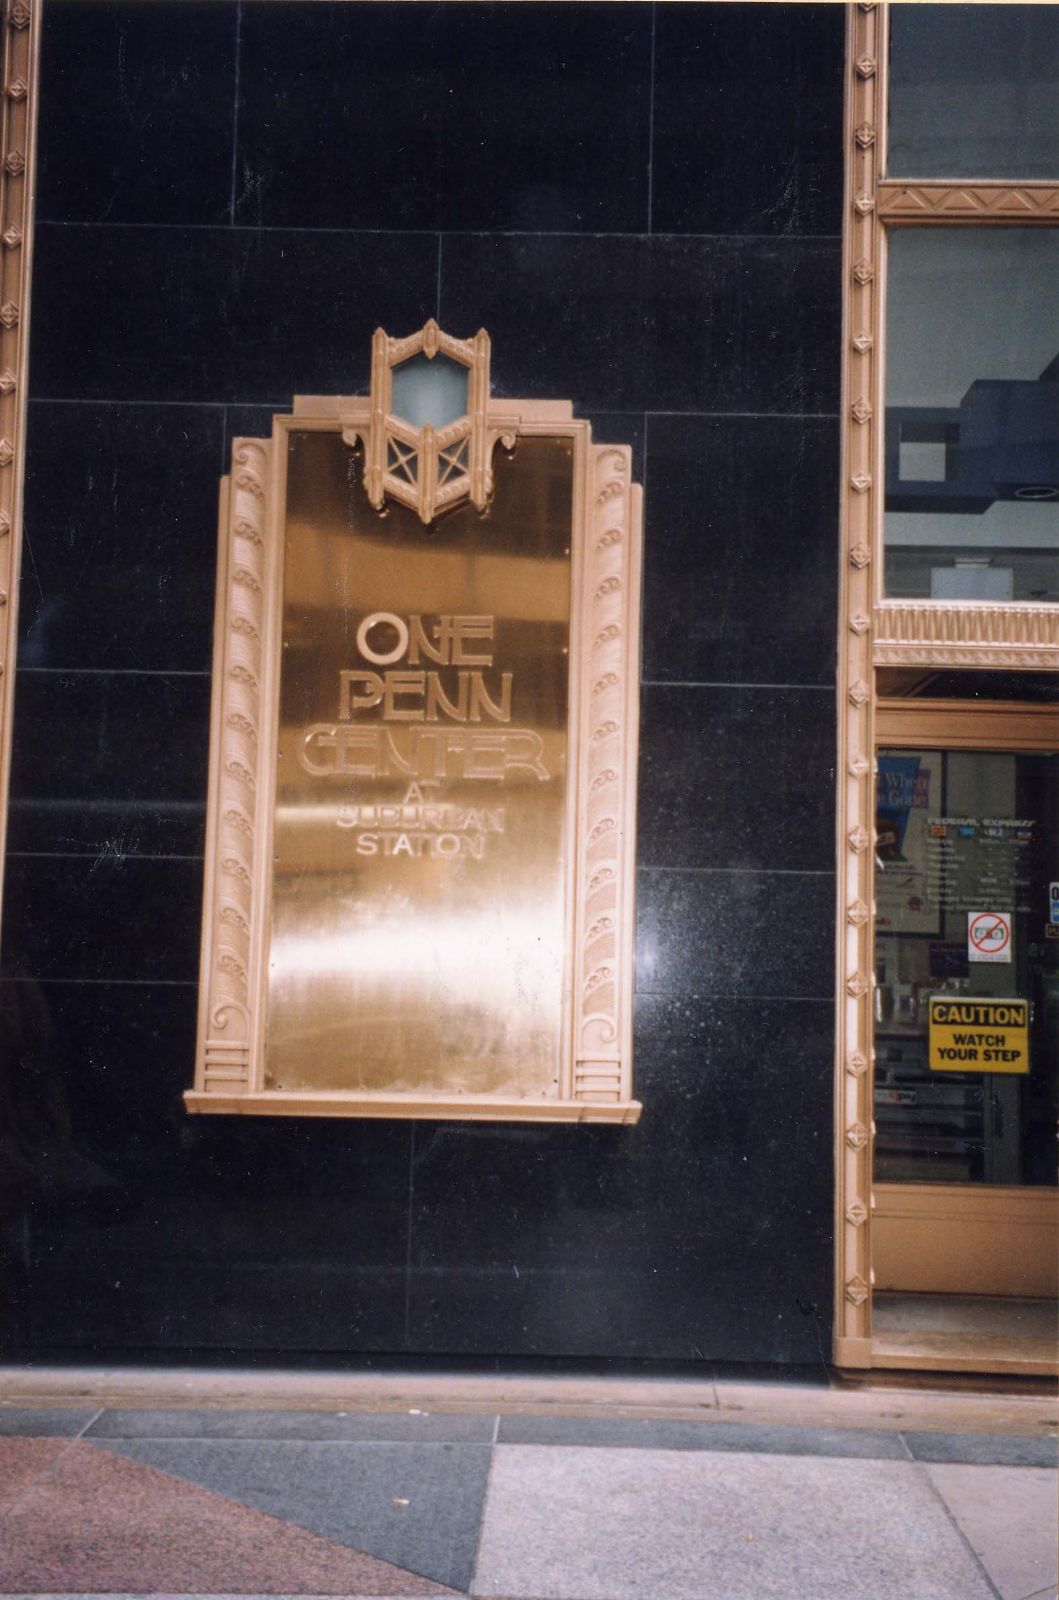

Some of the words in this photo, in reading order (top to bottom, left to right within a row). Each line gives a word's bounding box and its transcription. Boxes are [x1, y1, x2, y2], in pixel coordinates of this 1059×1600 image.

[356, 611, 494, 667] ONE
[339, 670, 513, 722] PENN
[298, 722, 551, 781] CENTER
[403, 780, 441, 805] AT
[336, 805, 505, 833] SUBURBAN
[356, 832, 486, 860] STATION
[932, 1006, 1025, 1025] CAUTION
[952, 1033, 1006, 1047] WATCH
[937, 1047, 978, 1061] YOUR
[983, 1049, 1022, 1062] STEP
